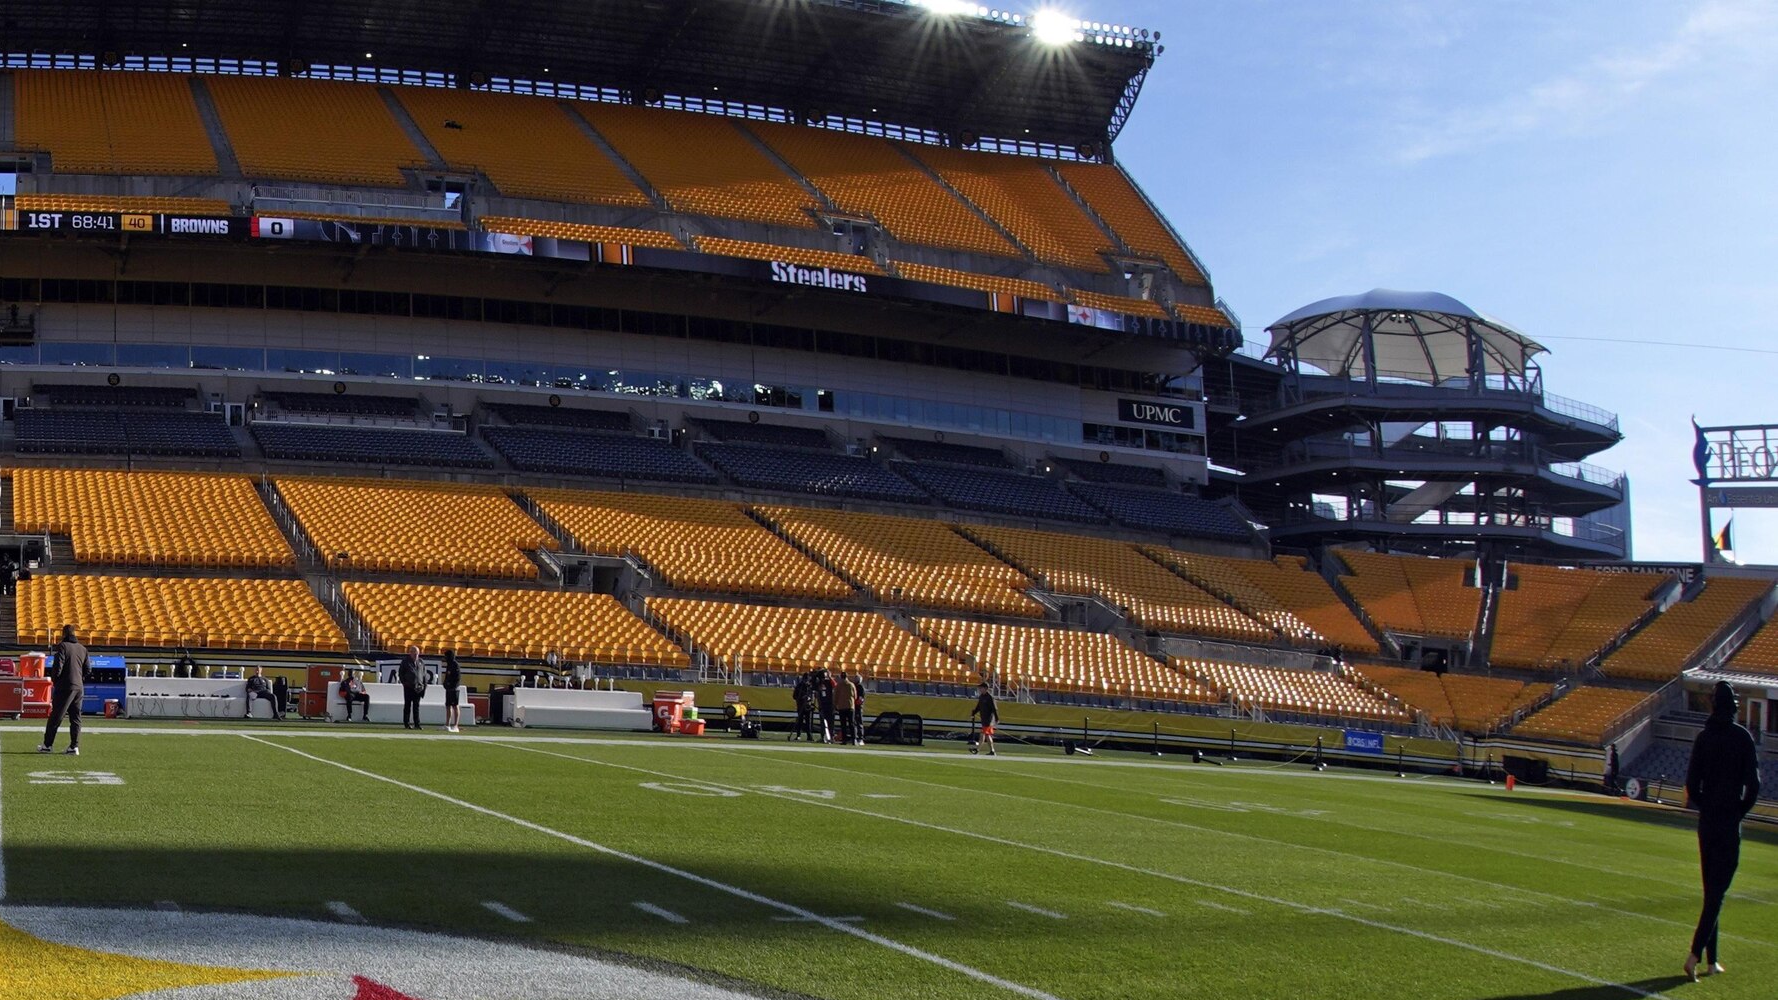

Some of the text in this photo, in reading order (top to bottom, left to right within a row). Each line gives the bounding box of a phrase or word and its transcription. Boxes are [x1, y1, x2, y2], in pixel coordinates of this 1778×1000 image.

[28, 213, 63, 229] 1ST
[72, 215, 115, 230] 68:41
[128, 217, 146, 229] 40
[171, 218, 229, 234] BROWNS
[270, 221, 283, 235] 0
[771, 261, 867, 293] Steelers
[1132, 403, 1182, 424] UPMC
